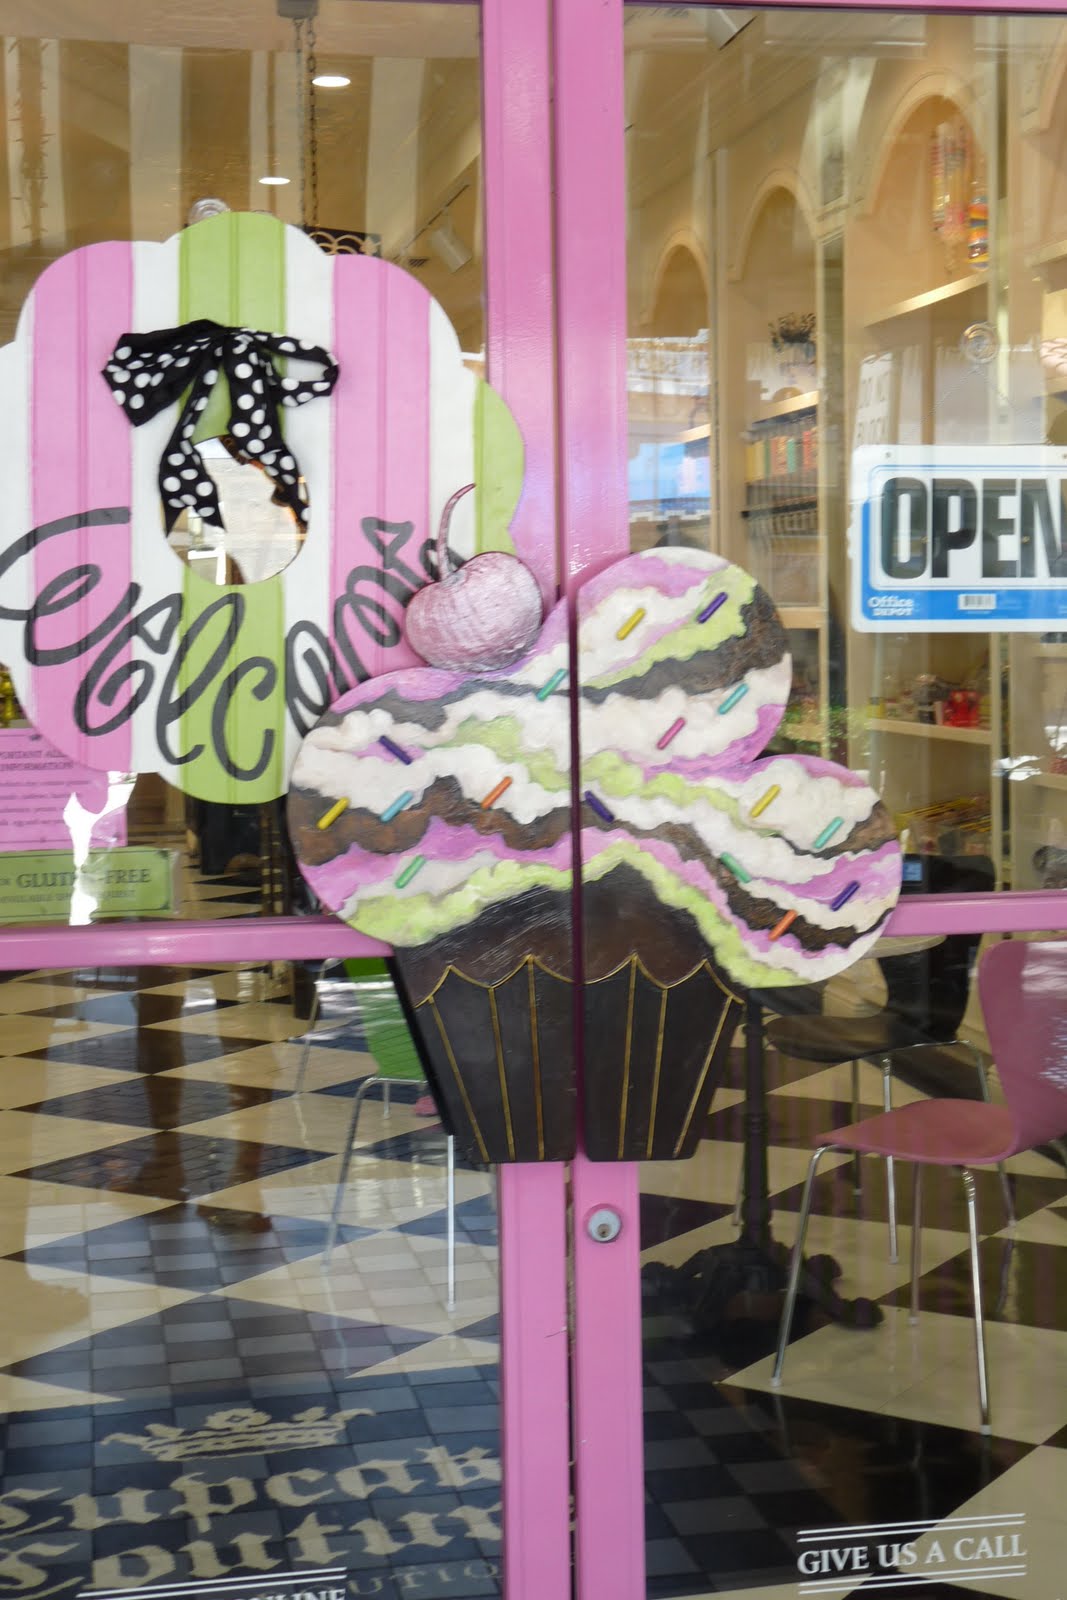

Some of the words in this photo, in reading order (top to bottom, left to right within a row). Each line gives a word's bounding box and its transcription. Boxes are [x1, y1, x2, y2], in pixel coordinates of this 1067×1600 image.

[881, 477, 1067, 579] OPEN
[797, 1546, 870, 1575] GIVE
[876, 1542, 918, 1568] US
[925, 1540, 946, 1564] A
[954, 1534, 1028, 1561] CALL
